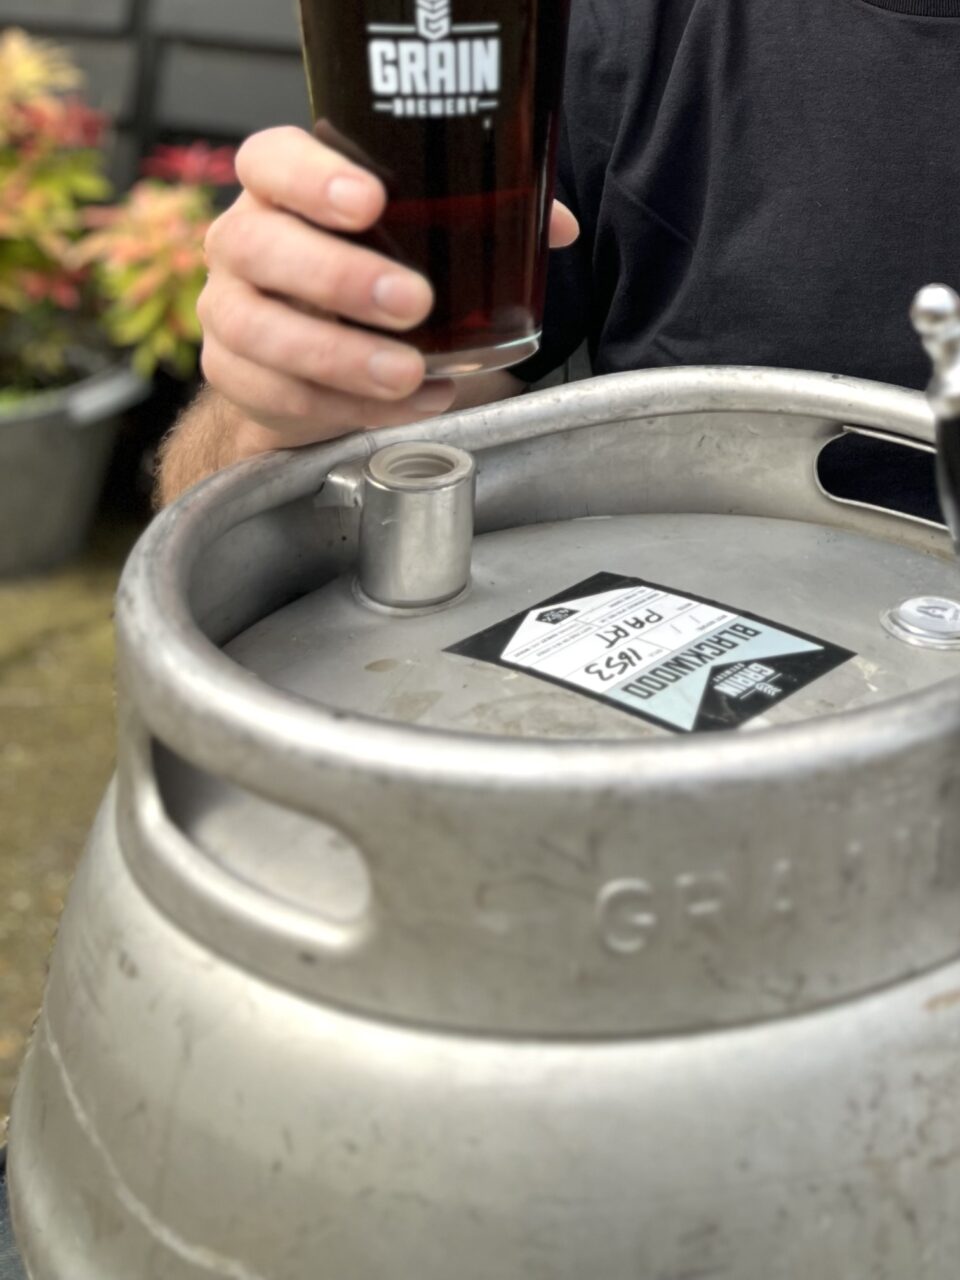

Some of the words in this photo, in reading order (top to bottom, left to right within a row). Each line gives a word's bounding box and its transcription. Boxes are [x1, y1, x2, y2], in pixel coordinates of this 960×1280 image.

[369, 39, 499, 95] GRAIN
[393, 98, 479, 116] BREWERY
[595, 608, 664, 649] PART
[584, 647, 643, 682] 1653
[621, 622, 762, 700] BLACKWOOD
[713, 662, 776, 698] GRAIN
